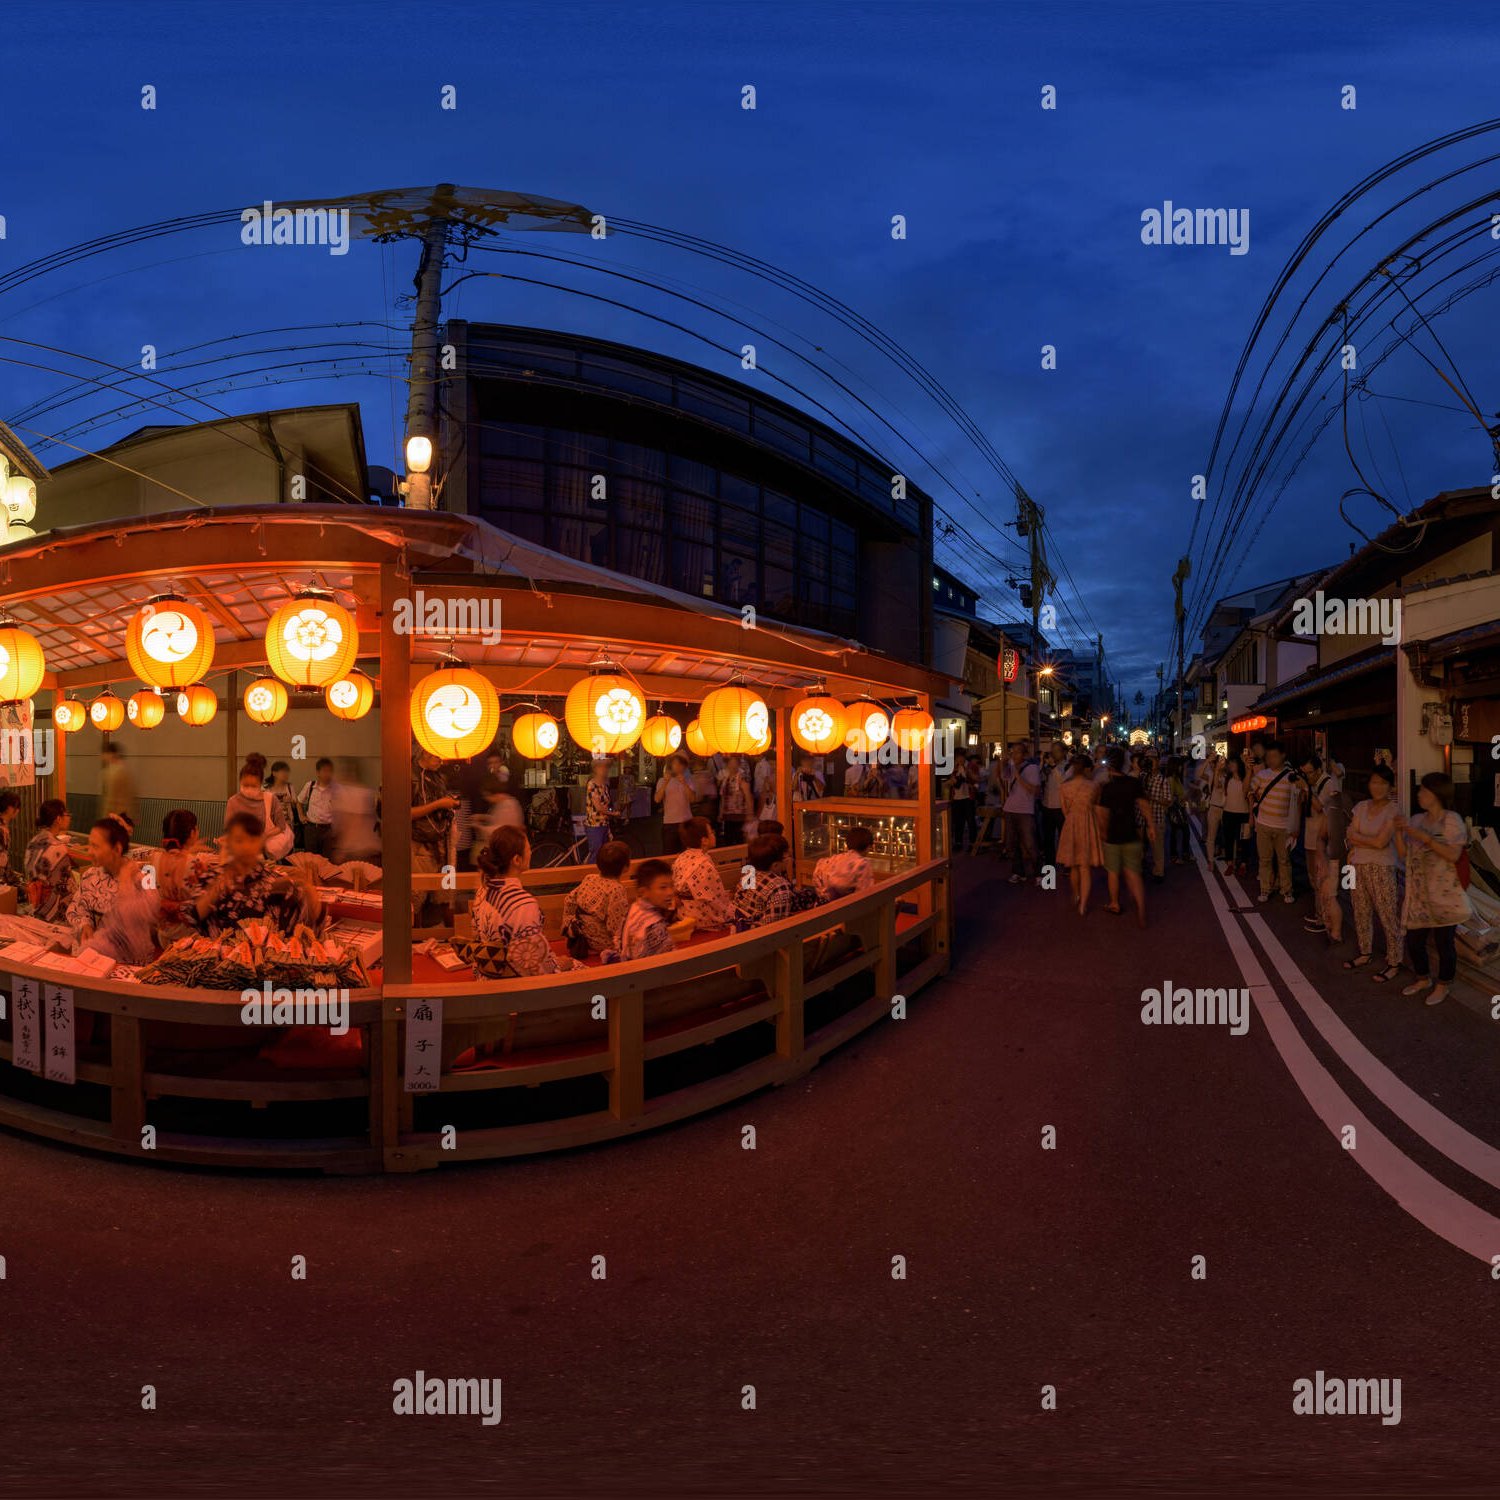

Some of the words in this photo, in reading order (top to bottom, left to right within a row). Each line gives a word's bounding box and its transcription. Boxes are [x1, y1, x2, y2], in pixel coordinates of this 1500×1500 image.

[17, 984, 35, 1020] 手拭い
[50, 992, 70, 1030] 手拭い
